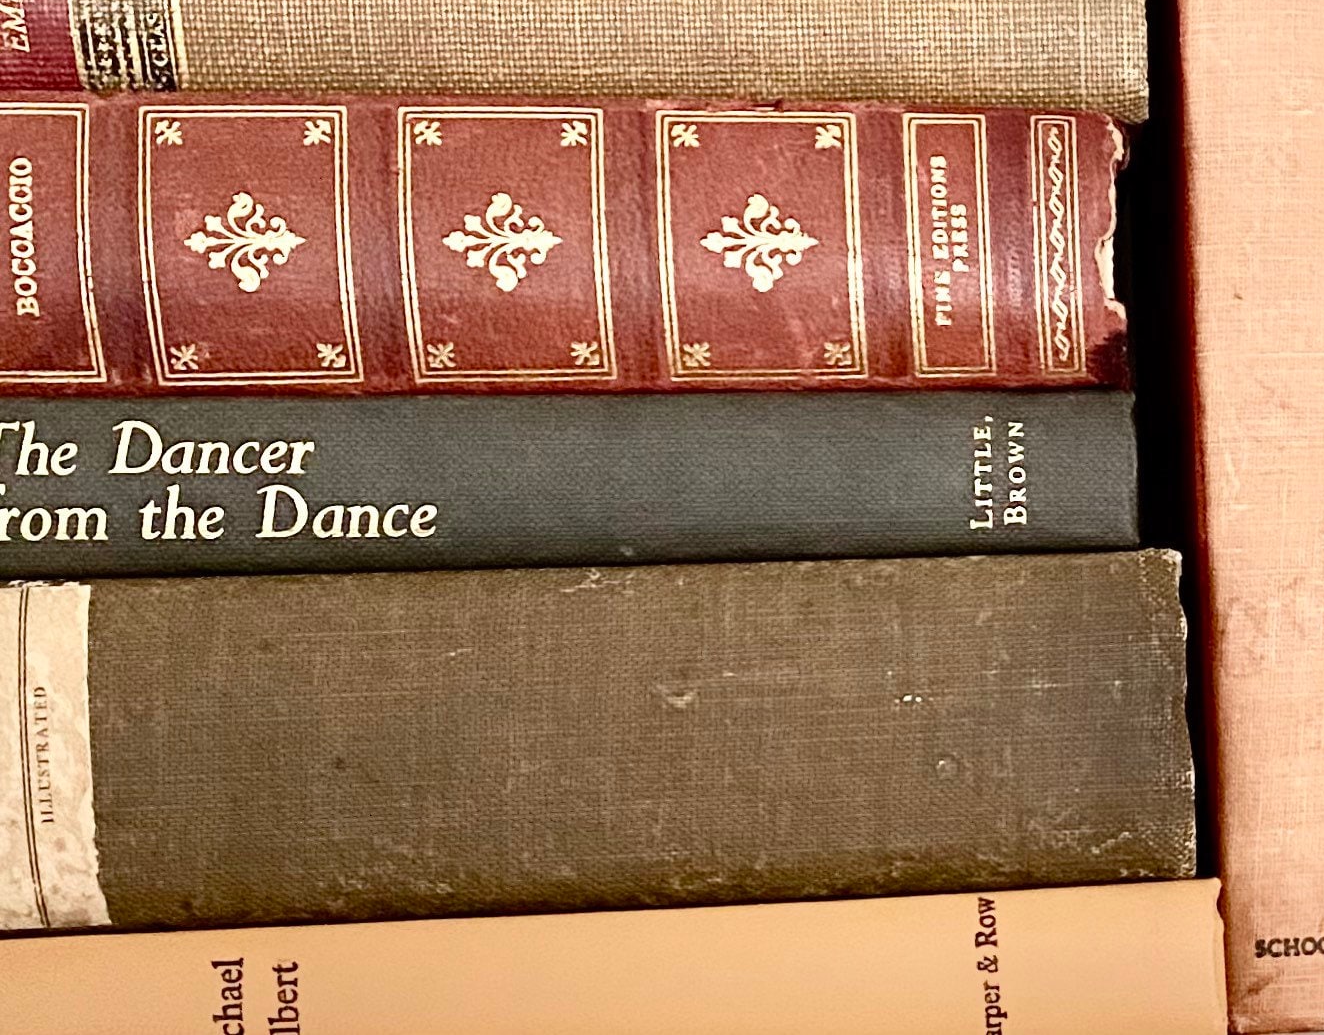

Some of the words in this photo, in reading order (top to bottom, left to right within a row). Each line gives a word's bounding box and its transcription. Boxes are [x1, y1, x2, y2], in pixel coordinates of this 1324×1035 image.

[929, 155, 951, 260] EDITIONS
[950, 203, 970, 273] PRESS
[934, 269, 952, 326] FINE
[108, 420, 316, 475] Dancer
[969, 415, 994, 530] LITTLE,
[1003, 421, 1028, 526] BROWN
[138, 484, 226, 541] the
[255, 483, 438, 539] Dance
[34, 685, 55, 824] ILLUSTRATED
[974, 896, 999, 948] Row
[976, 955, 999, 974] &
